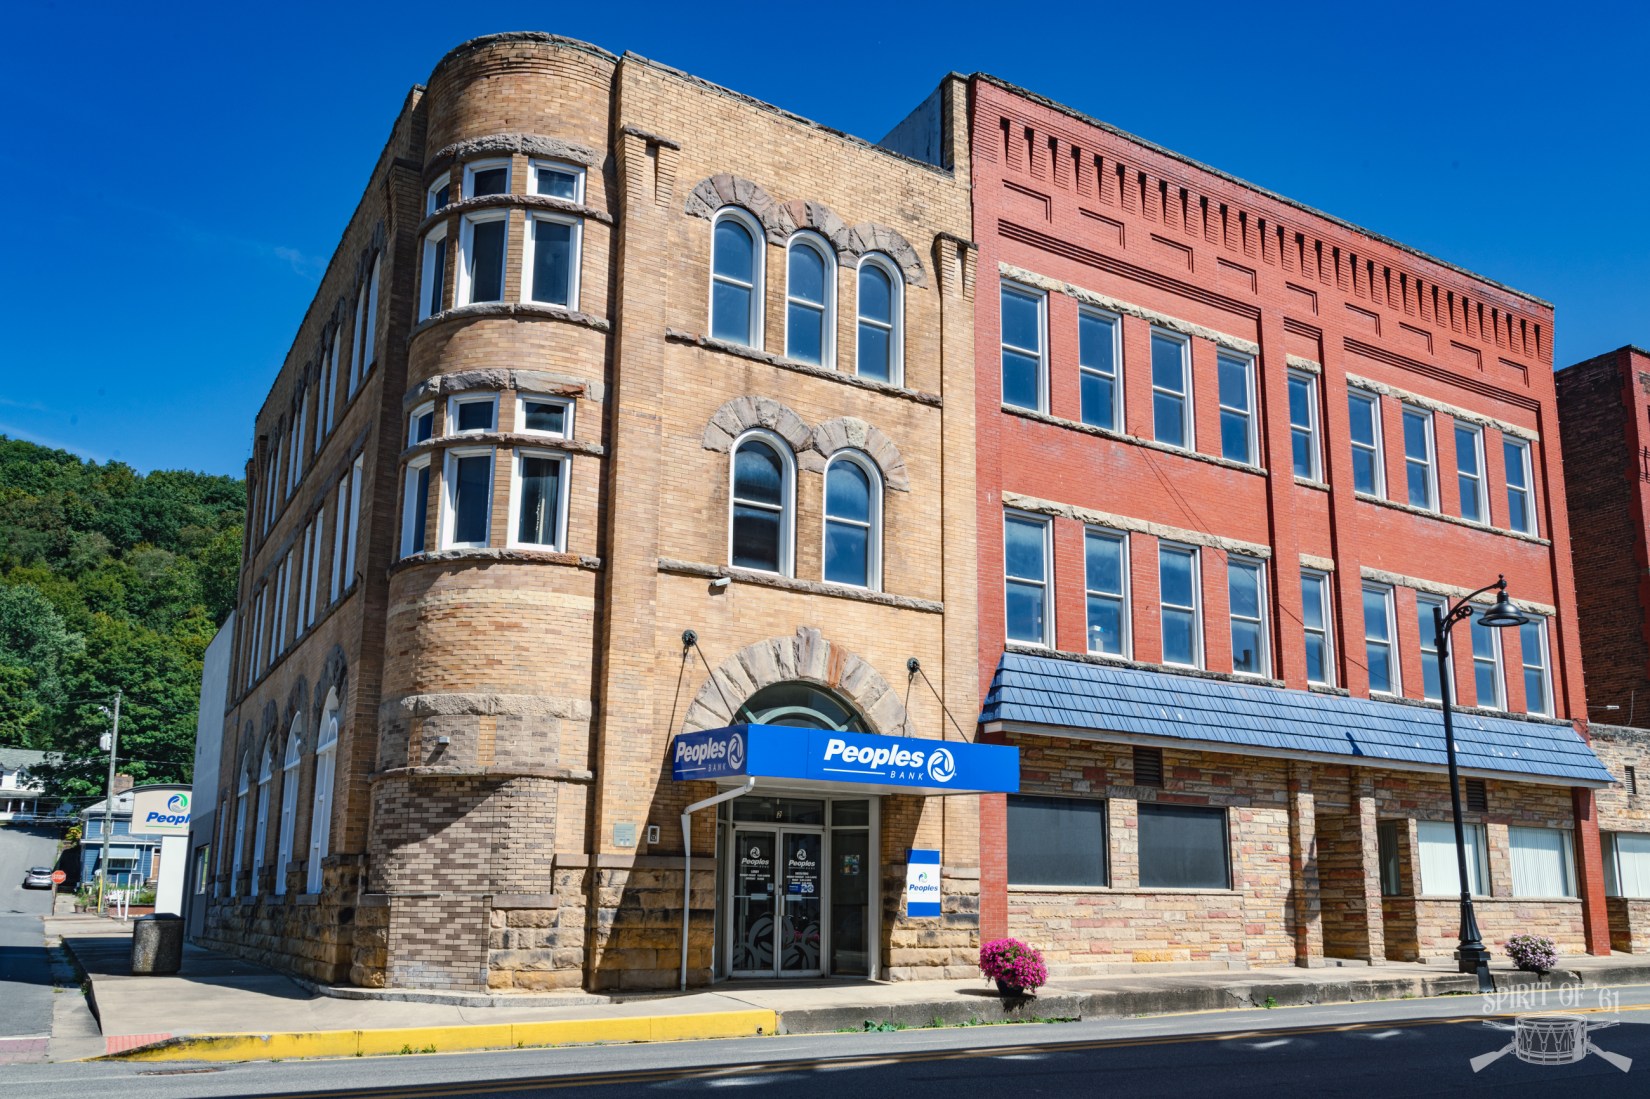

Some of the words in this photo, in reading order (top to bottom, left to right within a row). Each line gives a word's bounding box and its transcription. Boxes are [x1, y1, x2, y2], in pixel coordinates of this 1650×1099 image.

[675, 737, 726, 765] Peoples
[823, 738, 925, 769] Peoples
[708, 763, 726, 772] BANK
[890, 771, 924, 781] BANK
[146, 812, 191, 825] Peopl
[741, 857, 769, 866] Peoples
[788, 859, 816, 868] Peoples
[909, 884, 938, 892] Peoples
